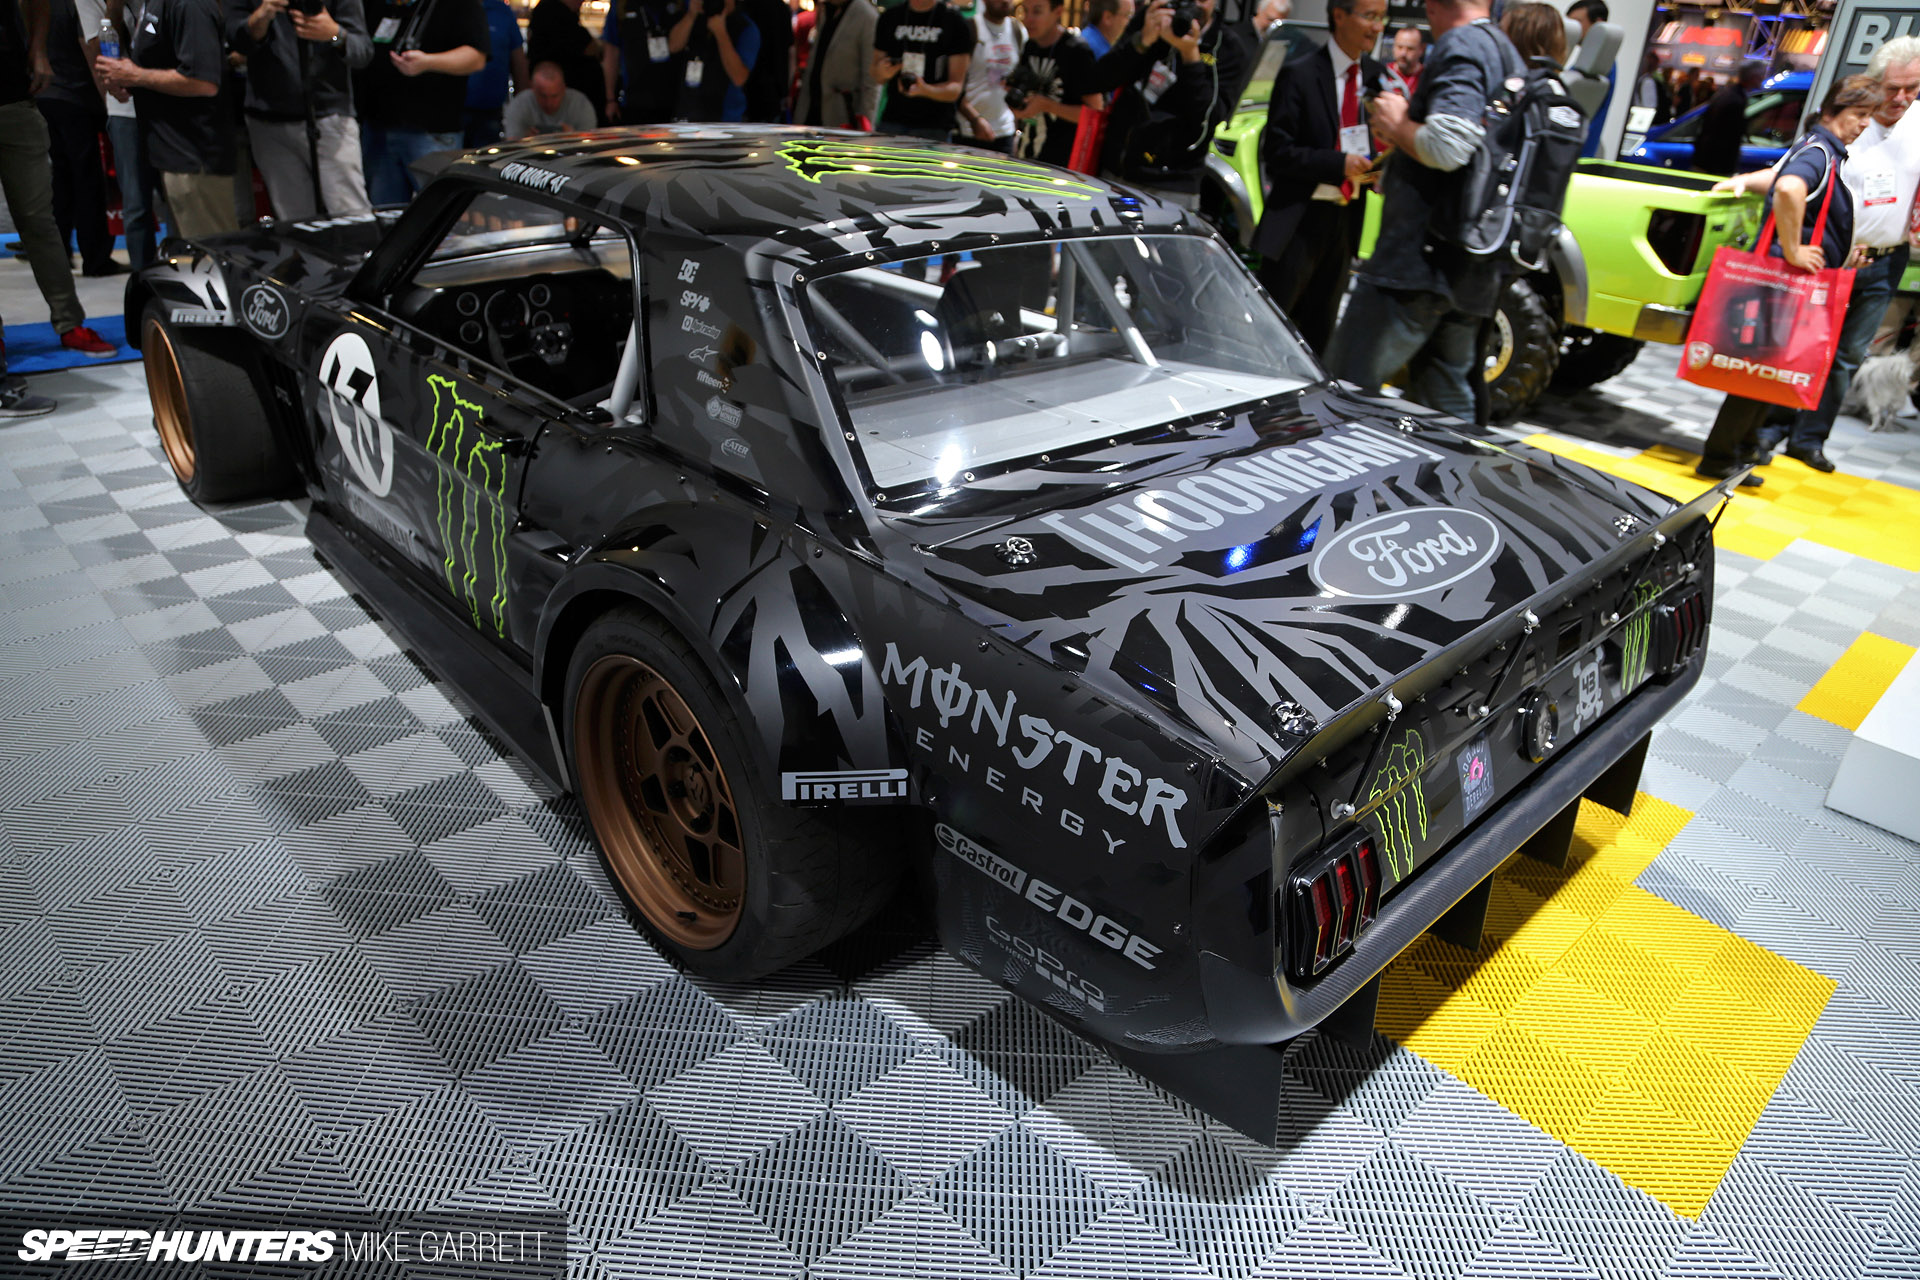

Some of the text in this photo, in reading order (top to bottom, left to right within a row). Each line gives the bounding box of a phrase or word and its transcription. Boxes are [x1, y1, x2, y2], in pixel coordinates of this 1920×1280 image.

[248, 289, 282, 333] Ford
[1711, 353, 1811, 388] SPYDER
[1347, 518, 1478, 588] Ford
[1582, 670, 1596, 695] 43
[879, 641, 1189, 850] MONSTER
[781, 768, 909, 801] PIRELLI
[915, 726, 1127, 855] ENERGY
[955, 837, 1164, 971] Castrol EDGE
